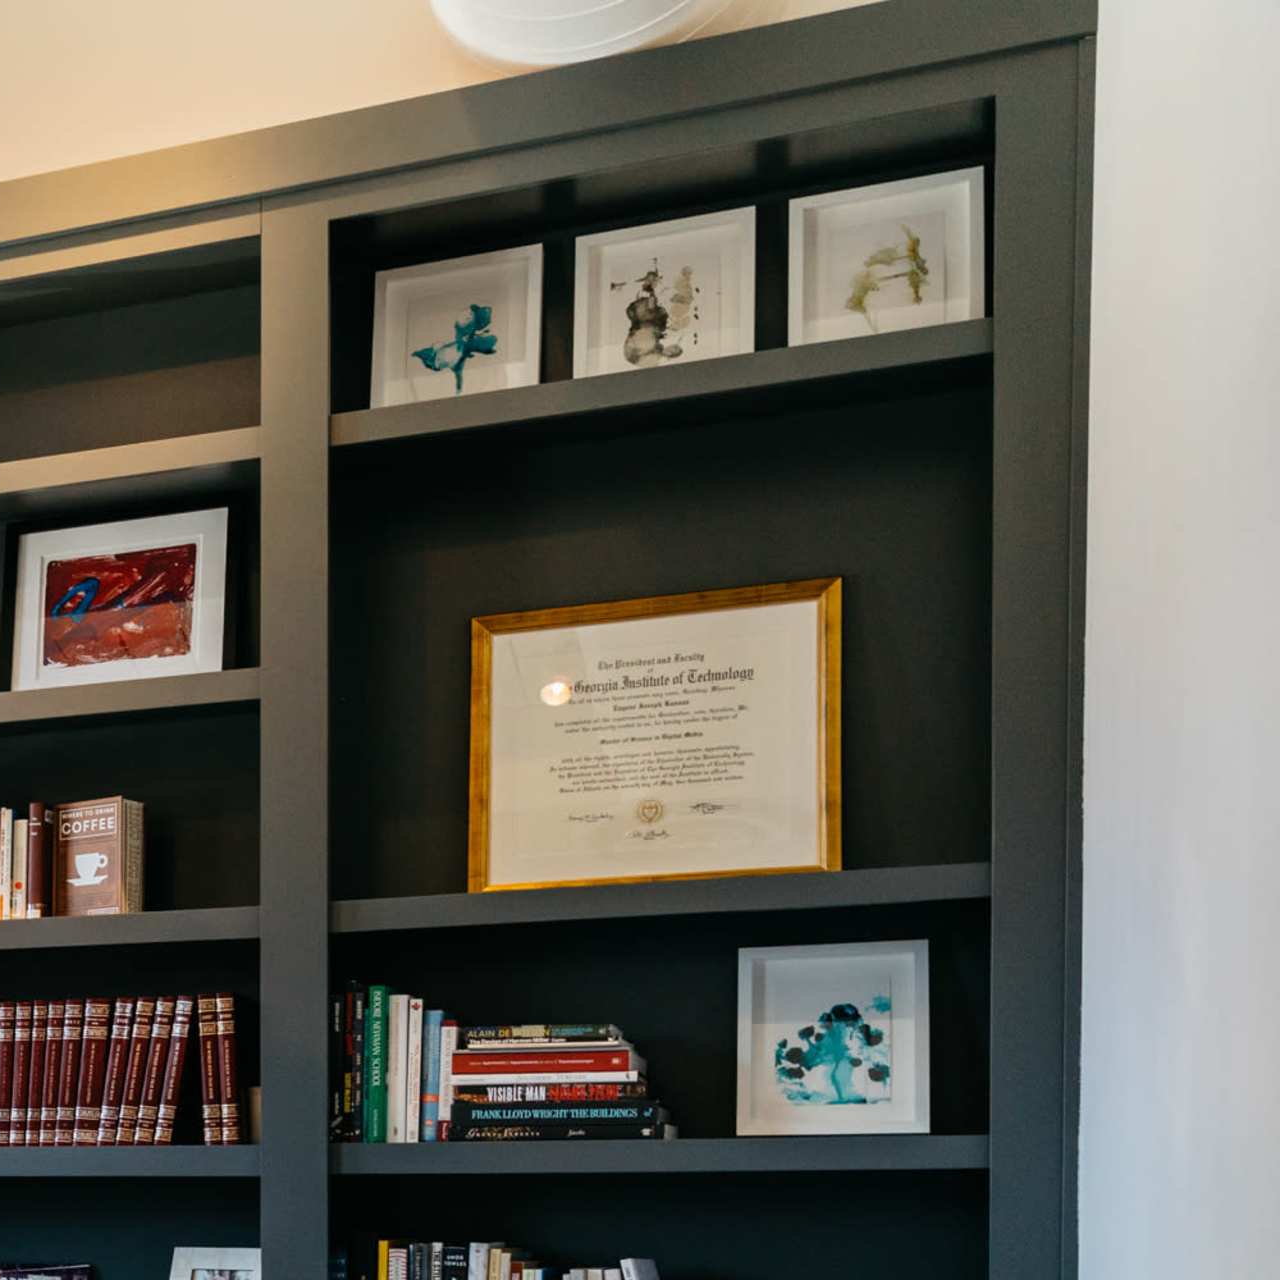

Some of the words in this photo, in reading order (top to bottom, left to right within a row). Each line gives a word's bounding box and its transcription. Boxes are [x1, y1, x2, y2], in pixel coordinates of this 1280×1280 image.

[574, 680, 618, 694] Georgia
[622, 675, 670, 690] Institute
[672, 671, 684, 685] of
[687, 667, 755, 683] Technology
[62, 816, 115, 834] COFFEE
[372, 1058, 381, 1086] SCHOOL
[487, 1086, 523, 1102] VISIBLE
[525, 1085, 546, 1101] MAN
[471, 1109, 501, 1120] FRANK
[503, 1109, 531, 1119] LLOYD
[533, 1108, 568, 1119] WRIGHT
[570, 1108, 588, 1118] THE
[590, 1108, 638, 1118] BUILDINGS
